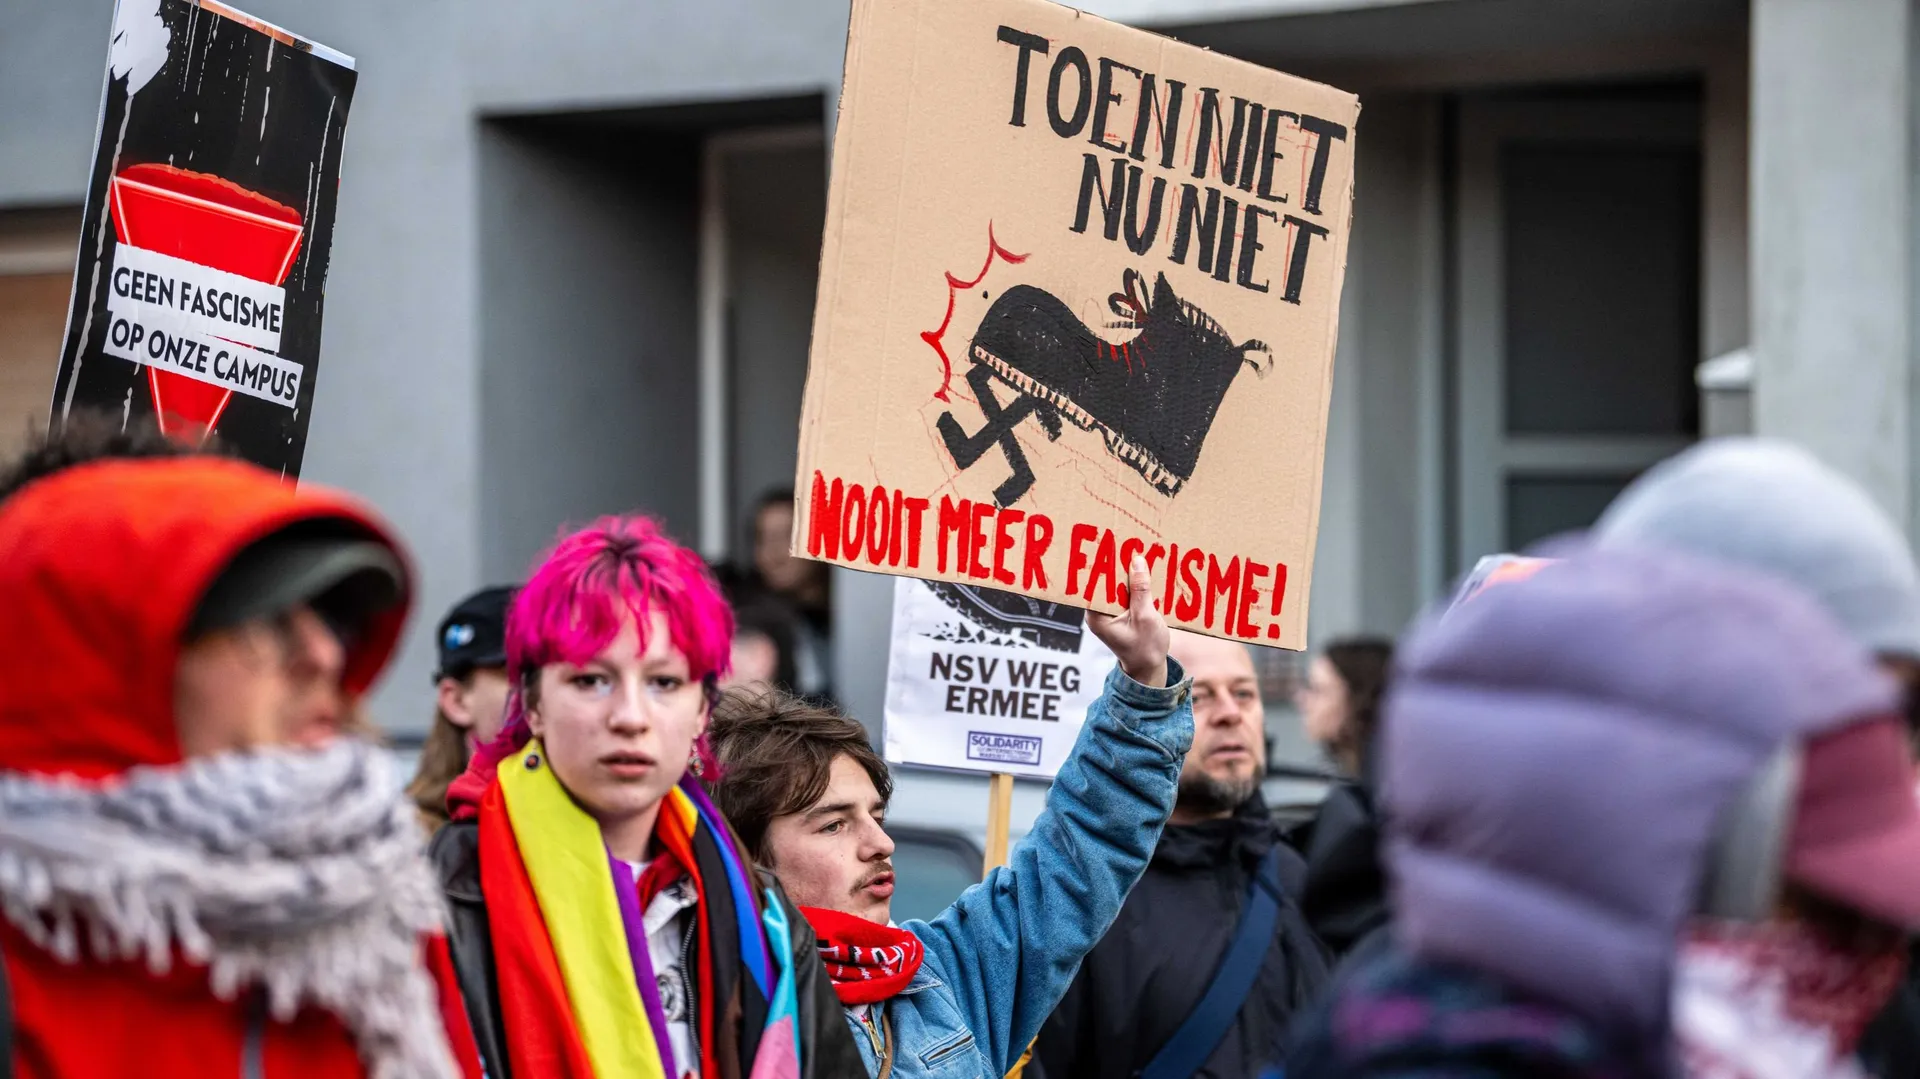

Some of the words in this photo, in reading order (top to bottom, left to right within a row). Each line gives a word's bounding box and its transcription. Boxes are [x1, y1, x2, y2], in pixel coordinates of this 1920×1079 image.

[996, 25, 1187, 169] TOEN
[1191, 87, 1347, 215] NIET
[1069, 153, 1167, 256] NU
[1168, 183, 1330, 305] NIET
[113, 266, 175, 308] GEEN
[180, 281, 281, 333] FASCISME
[111, 318, 145, 351] OP
[148, 330, 210, 374] ONZE
[213, 350, 298, 401] CAMPUS
[808, 469, 930, 569] NOOIT
[937, 493, 1054, 592] MEER
[929, 651, 999, 685] NSV
[1006, 659, 1081, 694] WEG
[944, 684, 1062, 722] ERMEE
[970, 735, 1039, 751] SOLIDARITY
